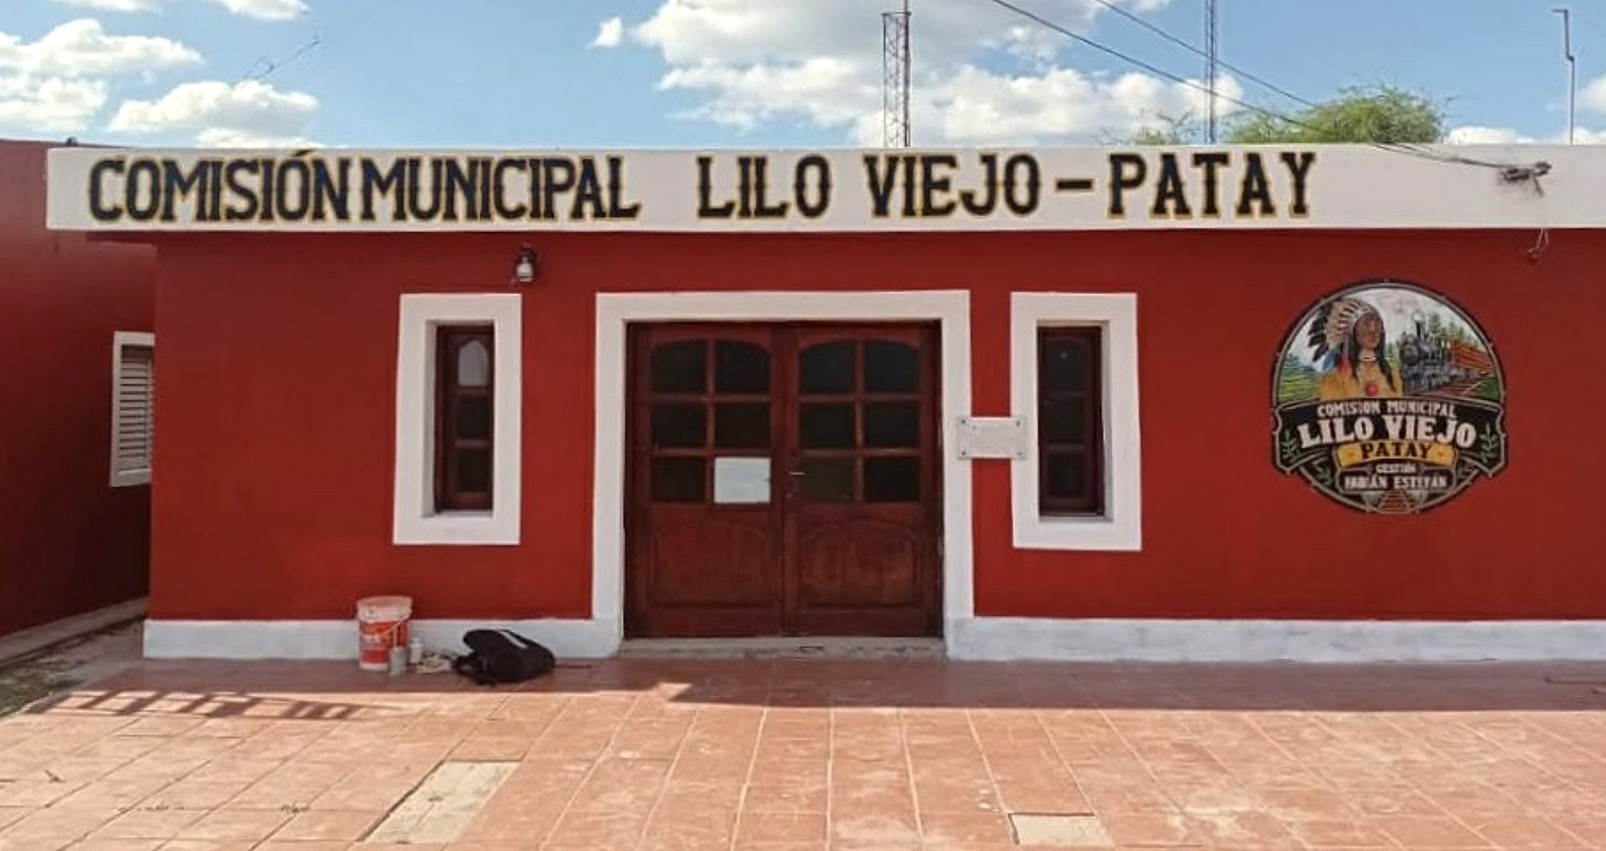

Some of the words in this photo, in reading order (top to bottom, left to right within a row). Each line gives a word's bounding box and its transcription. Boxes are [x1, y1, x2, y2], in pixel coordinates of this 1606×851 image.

[88, 149, 351, 223] COMISIÓN
[359, 154, 641, 222] MUNICIPAL
[695, 153, 832, 220] LILO
[864, 152, 1042, 219] VIEJO
[1107, 150, 1317, 219] PATAY
[1386, 401, 1457, 419] MUNICIPAL
[1298, 415, 1373, 449] LILO
[1383, 415, 1476, 448] VIEJO
[1360, 441, 1433, 459] PATAY
